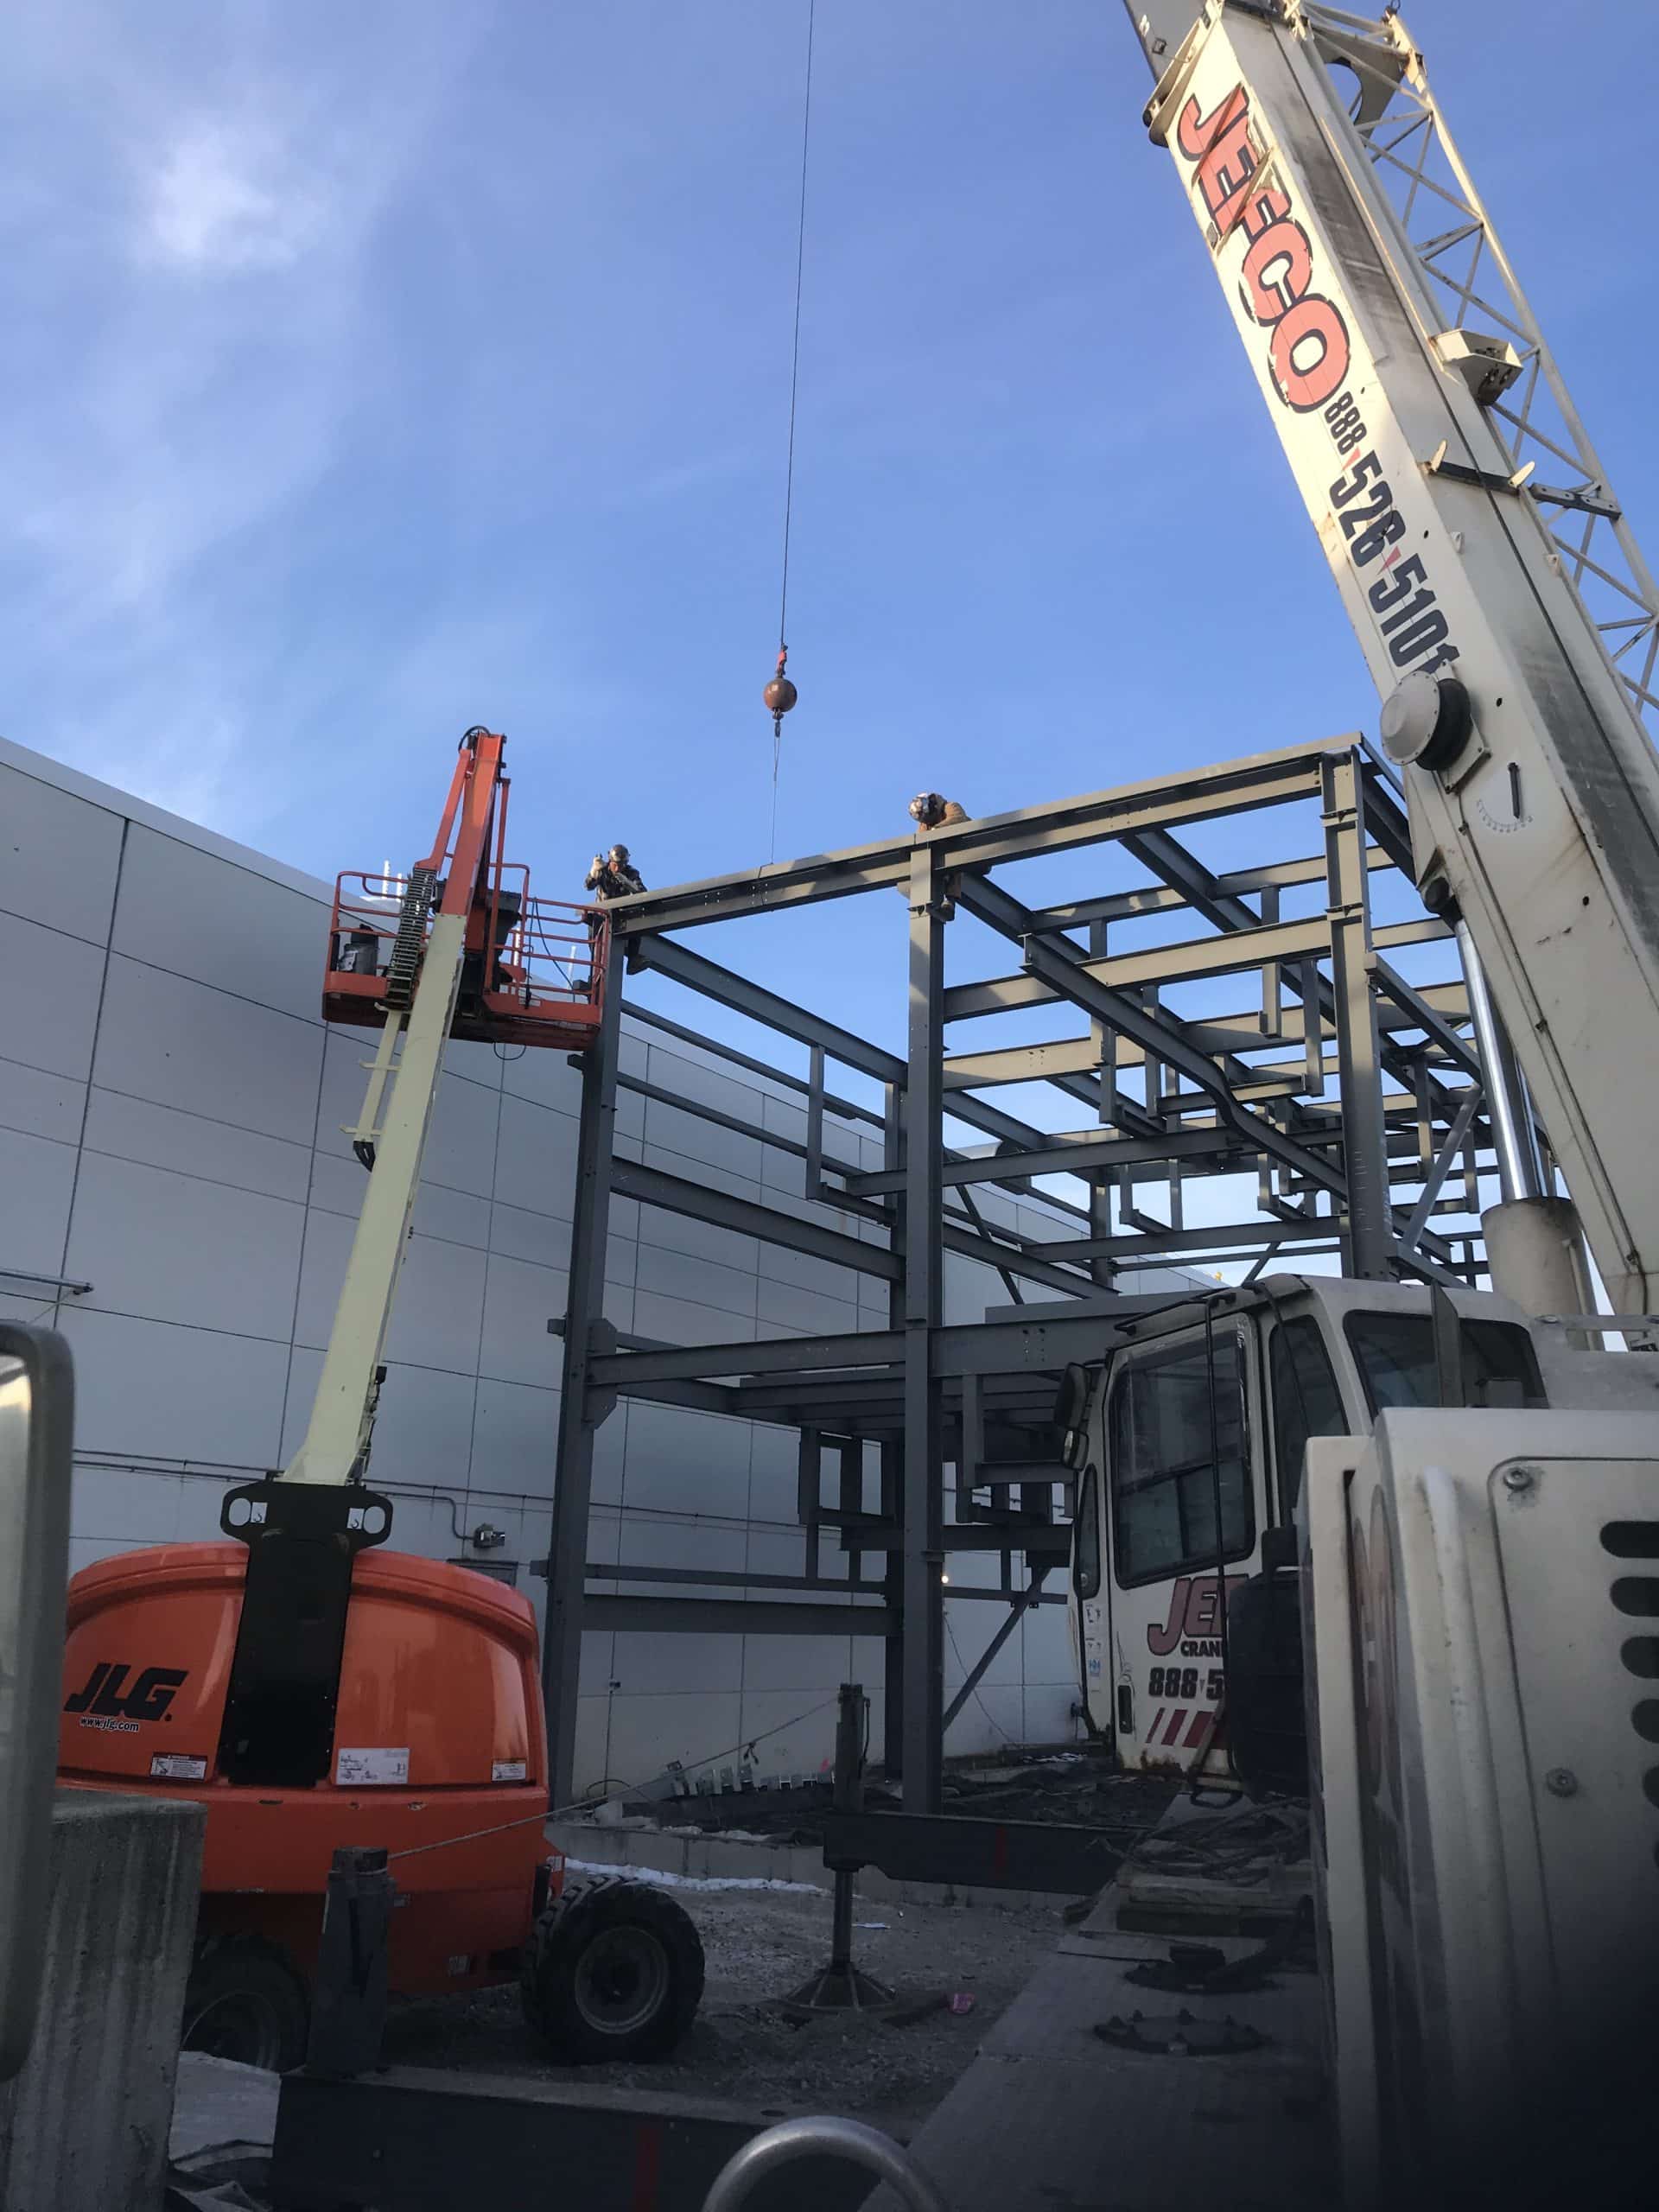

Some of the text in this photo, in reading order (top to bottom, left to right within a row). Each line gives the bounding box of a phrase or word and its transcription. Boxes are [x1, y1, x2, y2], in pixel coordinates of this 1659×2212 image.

[1177, 81, 1350, 414] JEFCO
[1324, 391, 1367, 455] 888
[1329, 449, 1406, 568] 526
[63, 1662, 189, 1722] JLG
[1148, 1667, 1198, 1699] 888
[79, 1715, 140, 1733] www.jlg.com
